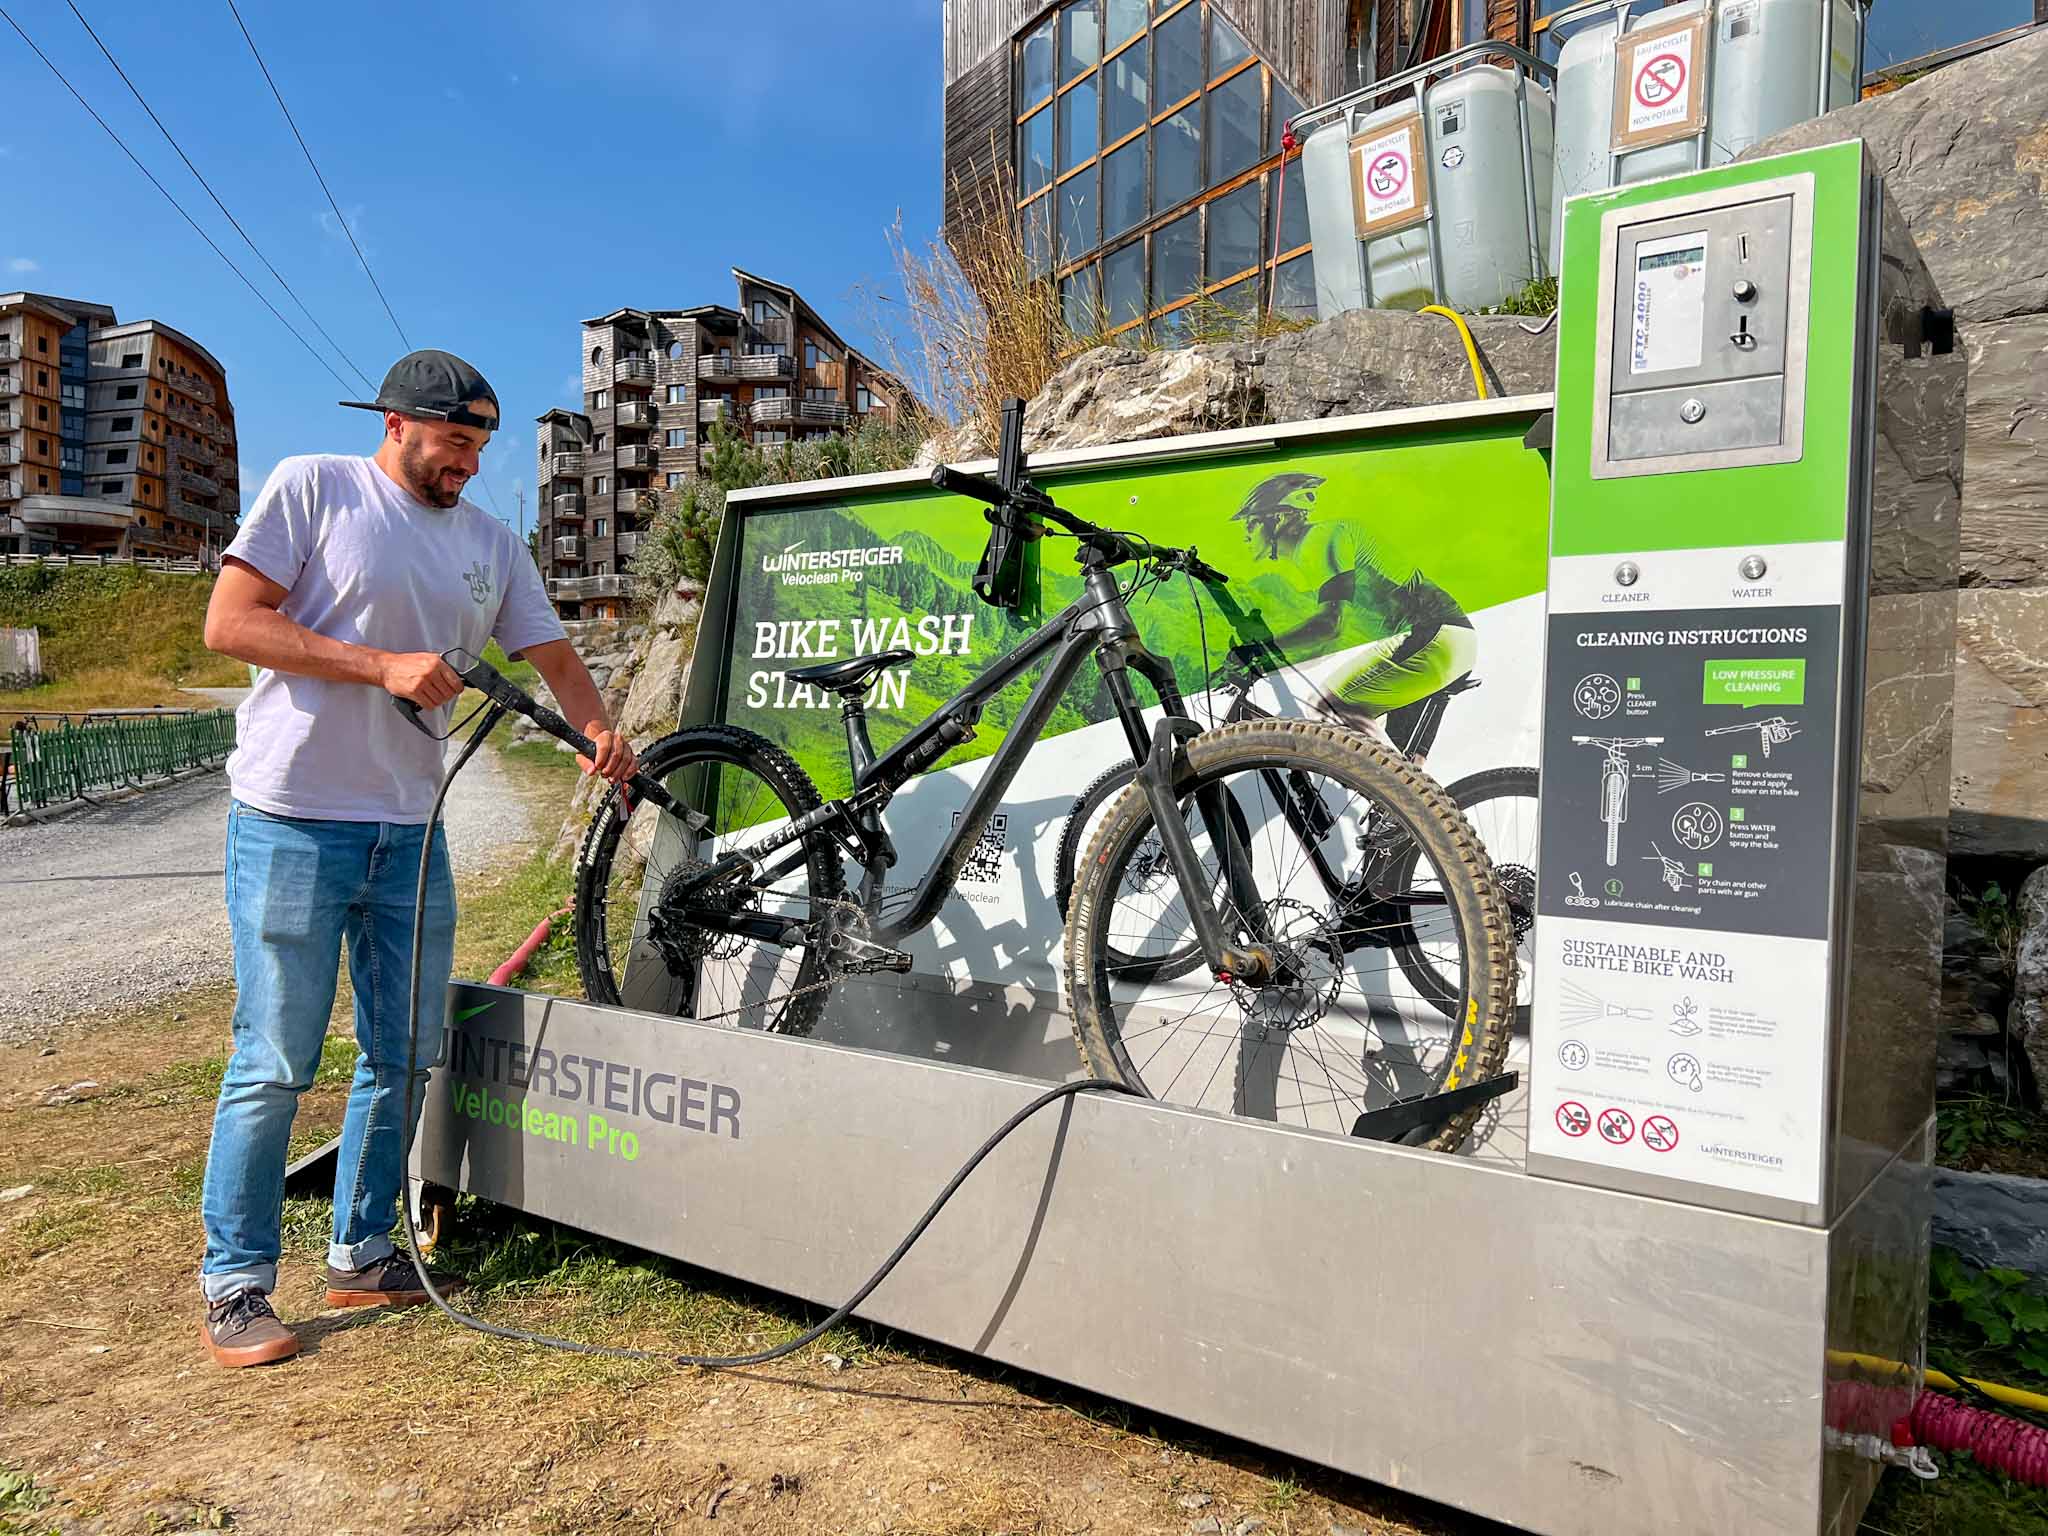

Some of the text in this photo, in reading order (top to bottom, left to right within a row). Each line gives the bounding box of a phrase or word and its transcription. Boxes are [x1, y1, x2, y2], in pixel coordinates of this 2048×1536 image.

[1633, 115, 1650, 126] NON
[1635, 281, 1647, 359] ETC 4000
[762, 545, 904, 573] WINTERSTEIGER
[781, 569, 863, 586] Veloclean Pro
[1601, 587, 1773, 603] CLEANER WATER
[752, 619, 840, 659] BIKE
[850, 614, 975, 657] WASH
[1576, 628, 1808, 647] CLEANING INSTRUCTIONS
[1712, 669, 1796, 680] LOW PRESSURE
[746, 670, 911, 709] STAON
[1724, 682, 1781, 692] CLEANING
[1626, 692, 1646, 700] Press
[1626, 700, 1657, 708] CLEANER
[1625, 707, 1649, 716] button
[1732, 770, 1793, 781] Remove cleaning
[1732, 778, 1788, 789] lance and apply
[1731, 787, 1757, 796] cleaner
[1769, 788, 1782, 796] the
[1783, 789, 1799, 797] bike
[1730, 823, 1776, 832] Press WATER
[1730, 831, 1769, 840] button and
[1729, 840, 1779, 849] spray the bike
[1698, 878, 1767, 890] Dry chain and other
[1698, 887, 1759, 898] parts with air gun
[1604, 900, 1635, 909] Lubricate
[1635, 901, 1653, 910] chain
[1653, 903, 1671, 911] after
[1075, 928, 1088, 985] MINION
[1563, 939, 1726, 968] SUSTAINABLE AND
[1562, 953, 1734, 983] GENTLE BIKE WASH
[451, 1029, 741, 1139] INTERSTEIGER
[450, 1079, 640, 1161] Veloclean Pro
[1700, 1144, 1783, 1165] WINTERSTEIGER
